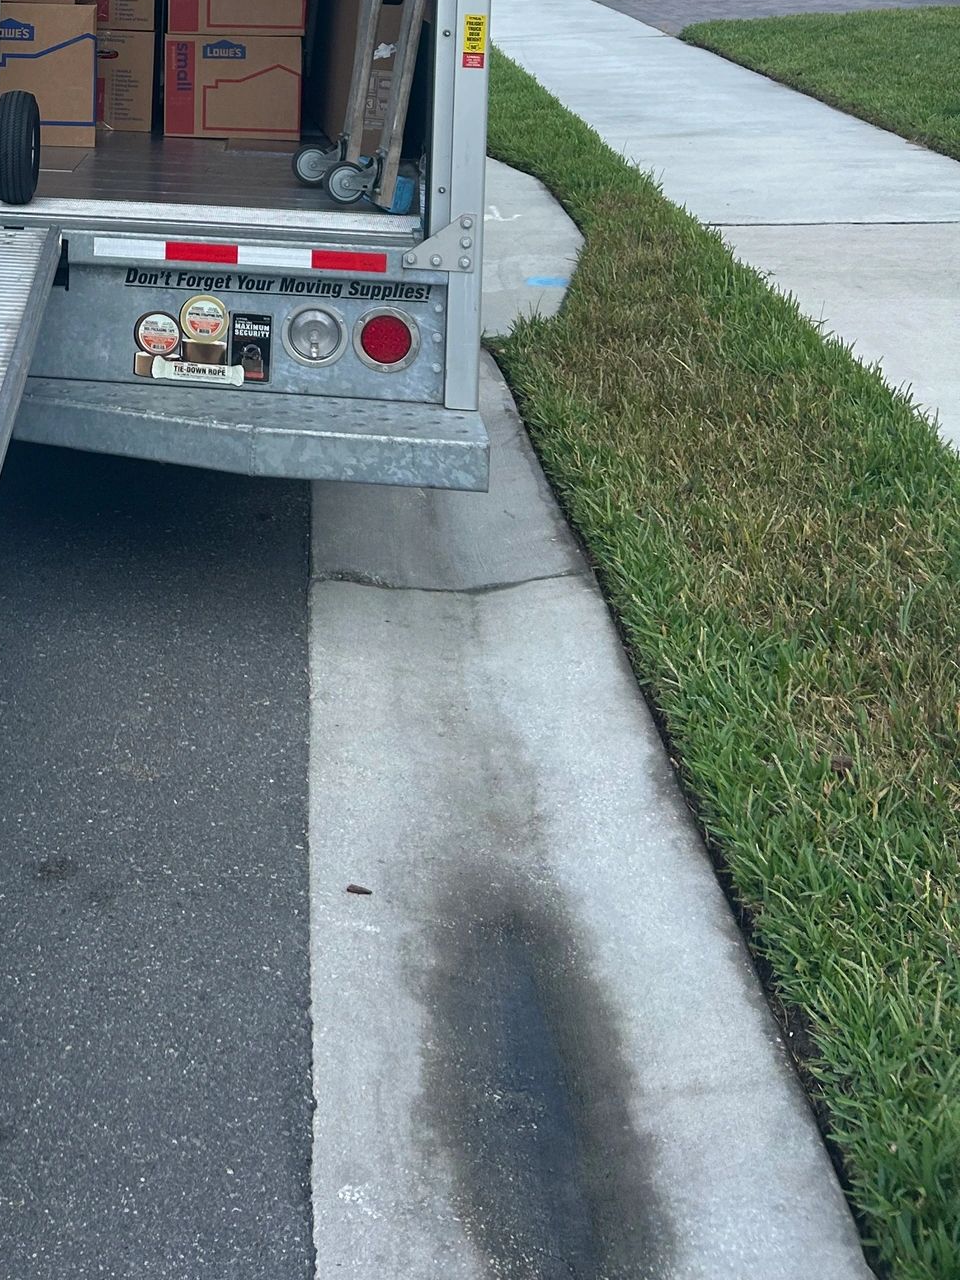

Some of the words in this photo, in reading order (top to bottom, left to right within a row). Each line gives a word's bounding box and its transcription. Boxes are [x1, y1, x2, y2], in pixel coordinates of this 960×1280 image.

[0, 26, 30, 38] OWE'S
[207, 46, 242, 57] LOWE'S
[176, 42, 193, 91] small
[125, 268, 172, 286] Don't
[176, 270, 232, 291] Forget
[237, 275, 276, 291] Your
[279, 278, 343, 298] Moving
[348, 280, 433, 301] Supplies!
[234, 322, 270, 332] MAXIMUM
[234, 329, 270, 338] SECURITY
[174, 365, 207, 375] TIE-DOWN
[208, 368, 227, 377] ROPE
